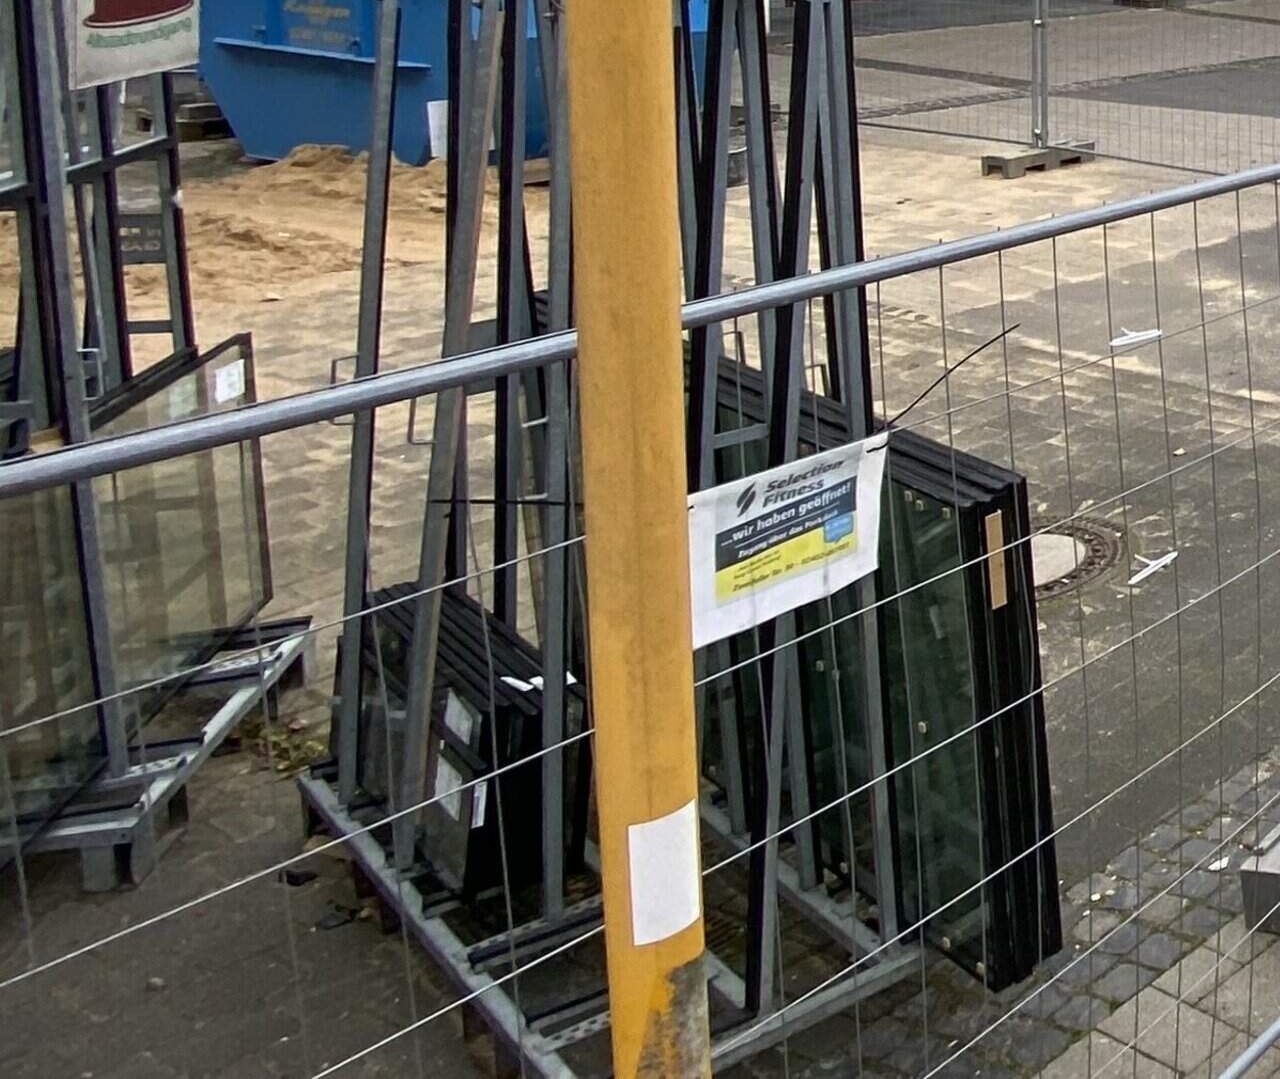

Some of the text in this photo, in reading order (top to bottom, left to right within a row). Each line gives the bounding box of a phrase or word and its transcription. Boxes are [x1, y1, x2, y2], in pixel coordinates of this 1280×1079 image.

[762, 478, 825, 508] Fitness
[764, 460, 845, 493] Selection
[756, 508, 796, 531] haben
[798, 482, 851, 516] geöffnet!
